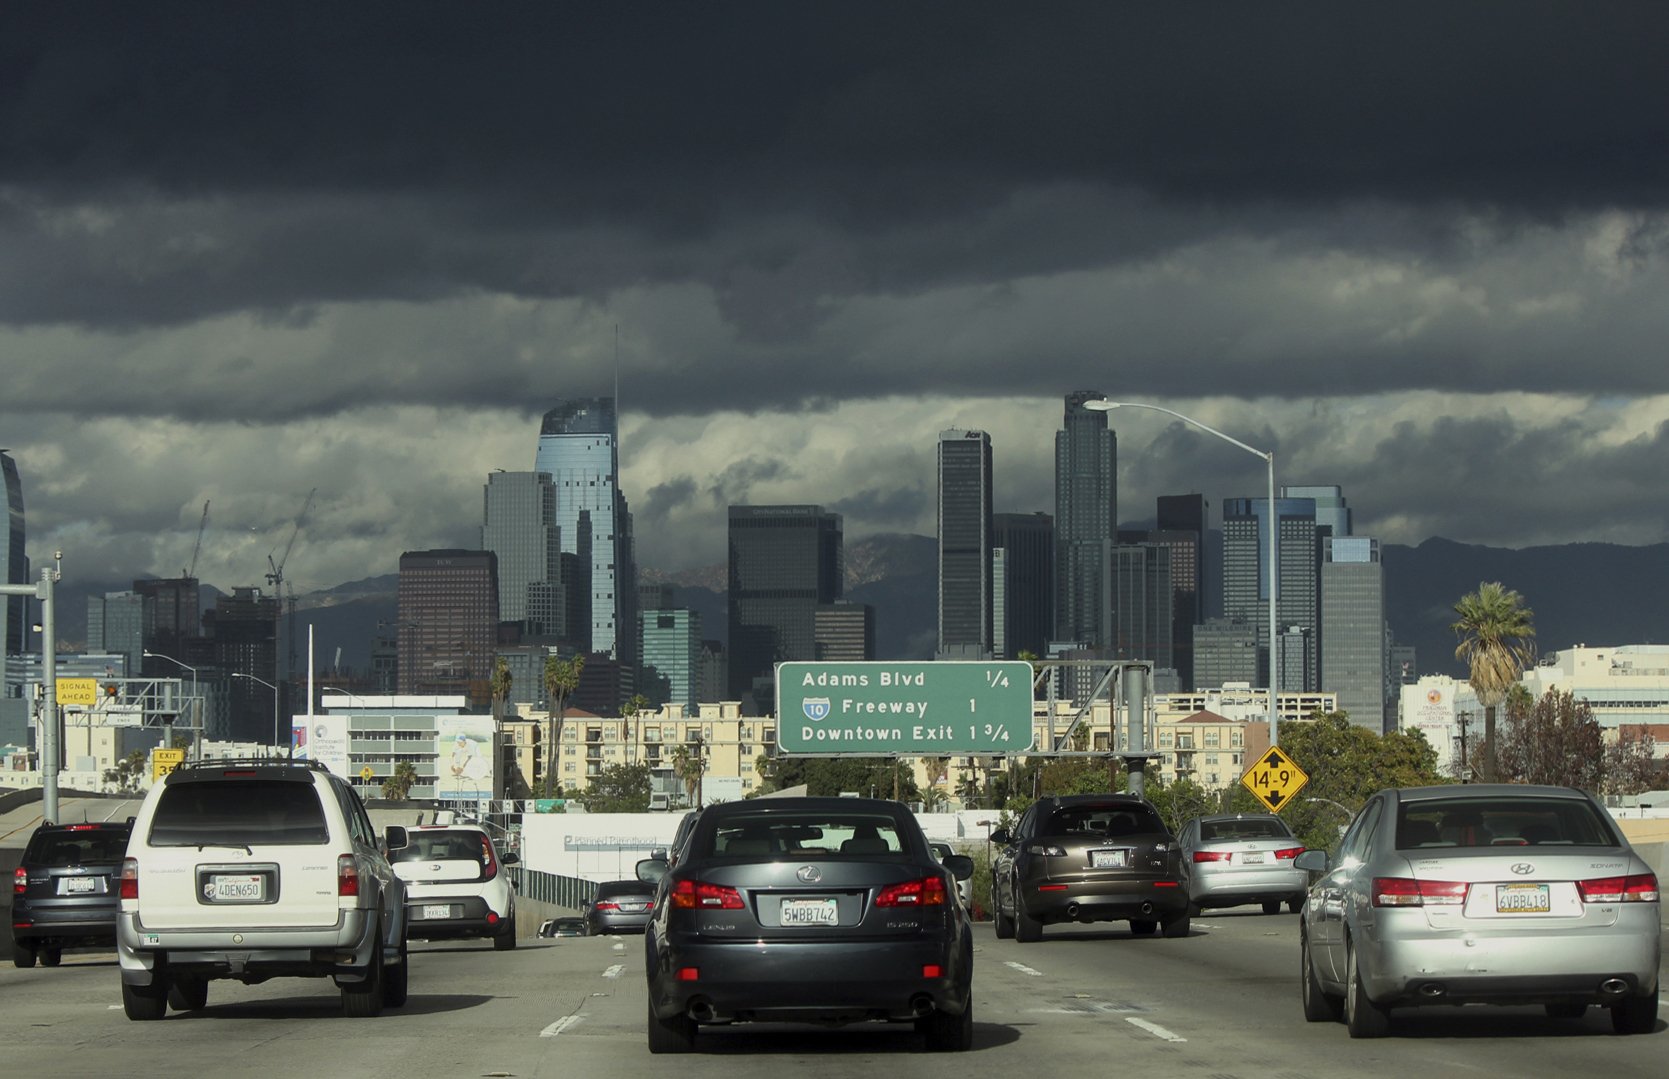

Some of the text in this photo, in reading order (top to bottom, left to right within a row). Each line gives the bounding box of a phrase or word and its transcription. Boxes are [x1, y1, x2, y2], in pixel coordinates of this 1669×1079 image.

[802, 670, 1009, 688] Adams Blvd 1/4
[60, 683, 91, 691] SIGNAL
[61, 693, 91, 701] AHEAD
[810, 698, 976, 719] 10 Freeway 1
[802, 726, 902, 742] Downtown
[913, 726, 954, 741] Exit
[969, 726, 976, 741] 1
[159, 752, 177, 760] EXIT
[575, 836, 608, 847] Planned
[219, 884, 258, 896] 4DEN650
[1499, 894, 1547, 909] 6VBB418
[783, 907, 835, 922] 5WBB742
